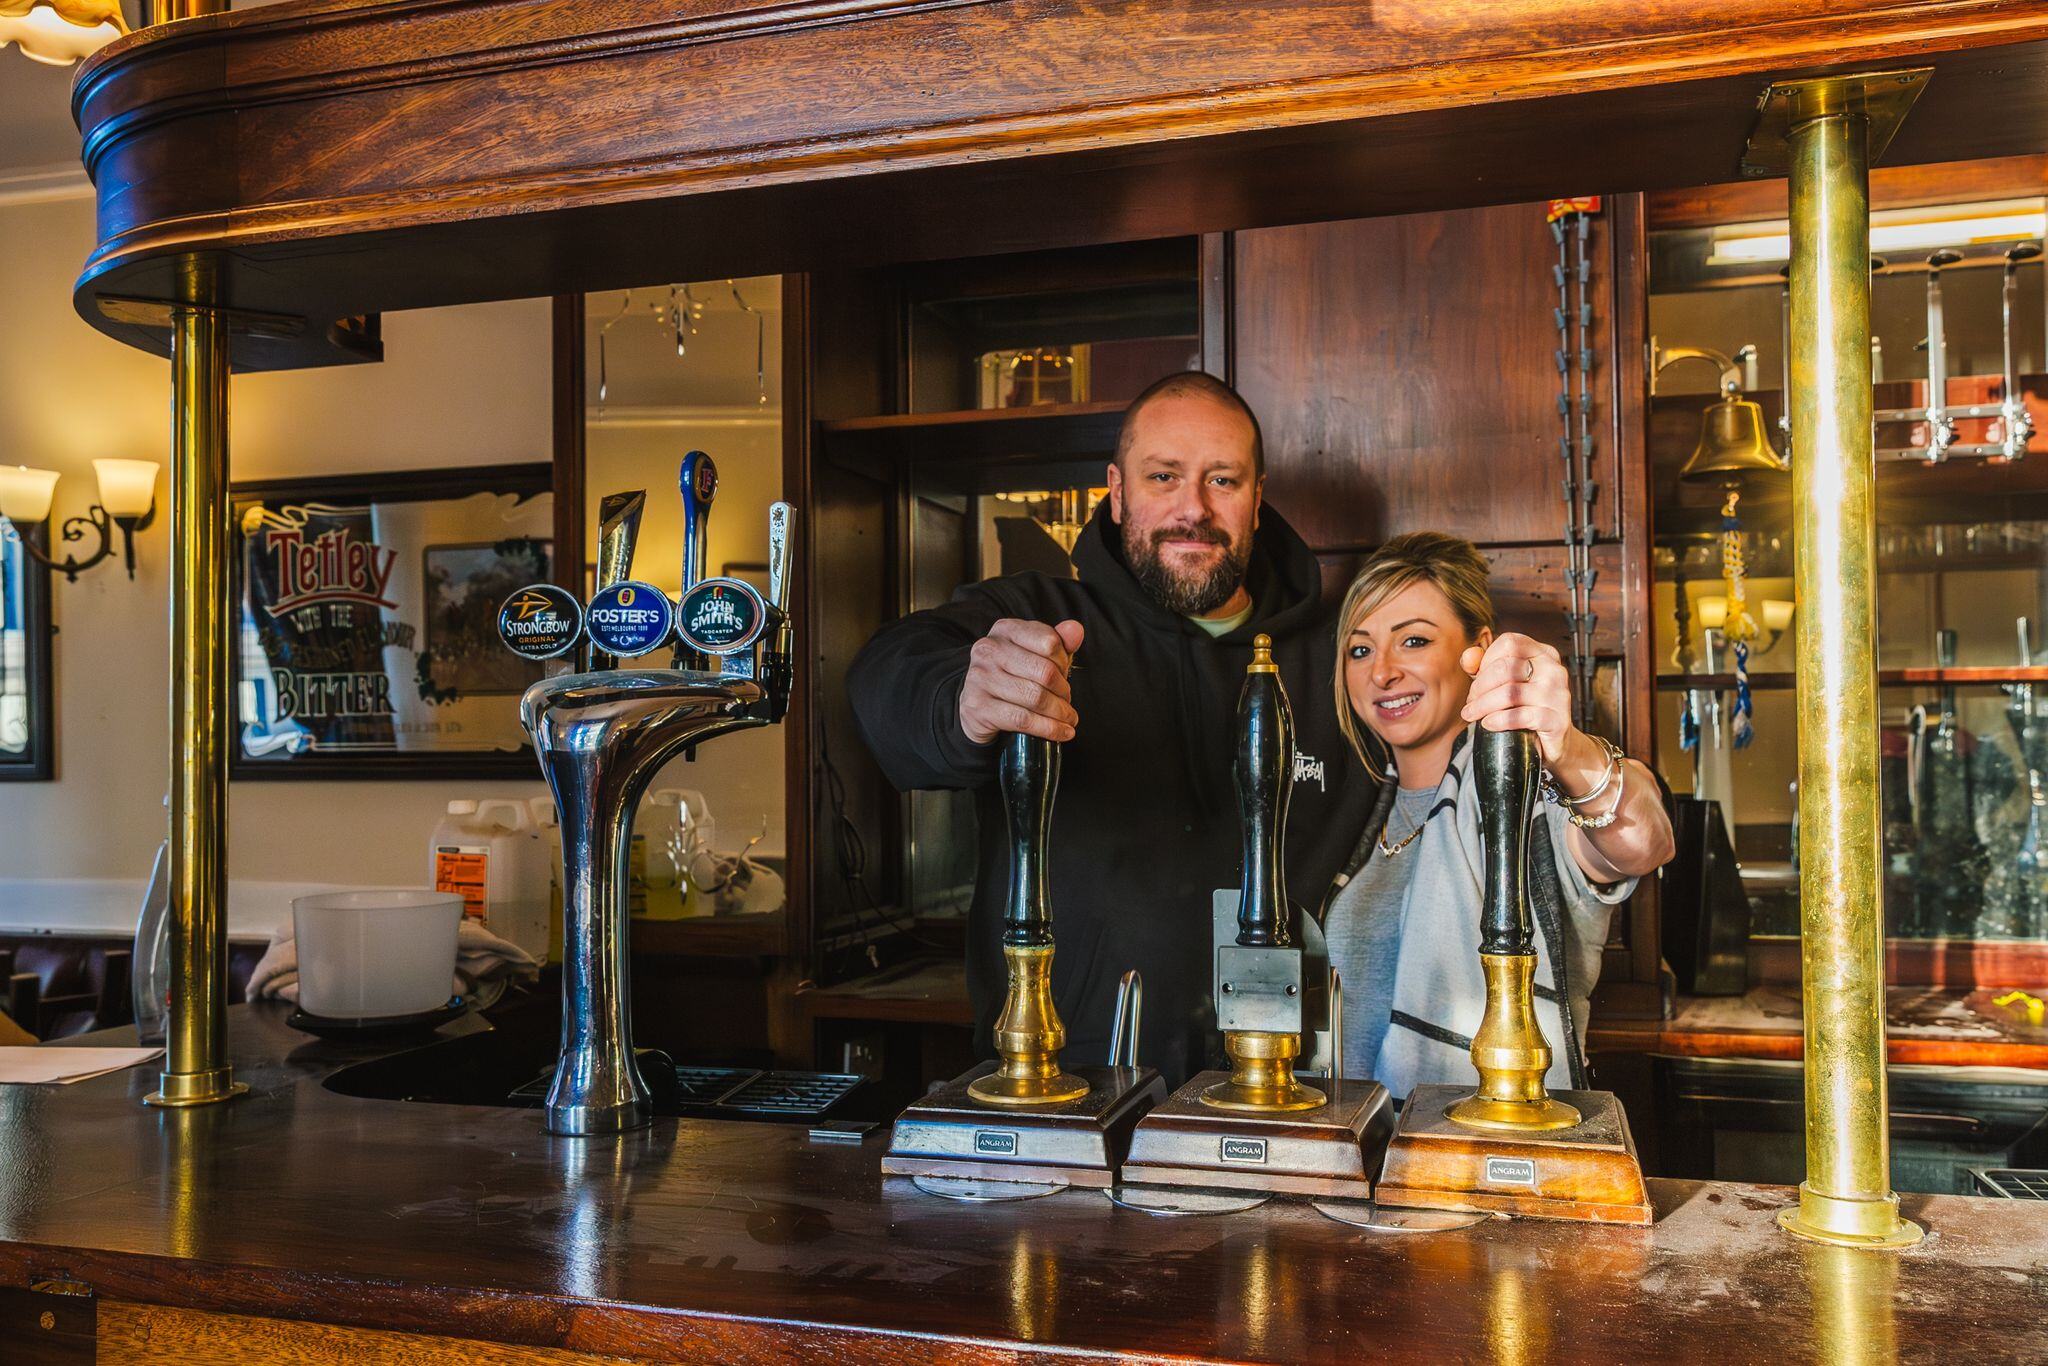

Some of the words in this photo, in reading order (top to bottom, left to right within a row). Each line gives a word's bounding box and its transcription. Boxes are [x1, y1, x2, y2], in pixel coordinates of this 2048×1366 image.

[266, 528, 398, 601] Tetley
[697, 600, 735, 615] JOHN
[592, 609, 660, 623] FOSTER'S
[691, 611, 743, 632] SMITH'S
[506, 620, 570, 637] STRONGBOW
[518, 635, 556, 644] ORIGINAL
[272, 667, 397, 723] BITTER
[980, 1139, 1012, 1147] ANGRAM
[1226, 1146, 1261, 1154] ANGRAM
[1491, 1167, 1529, 1176] ANGRAM
